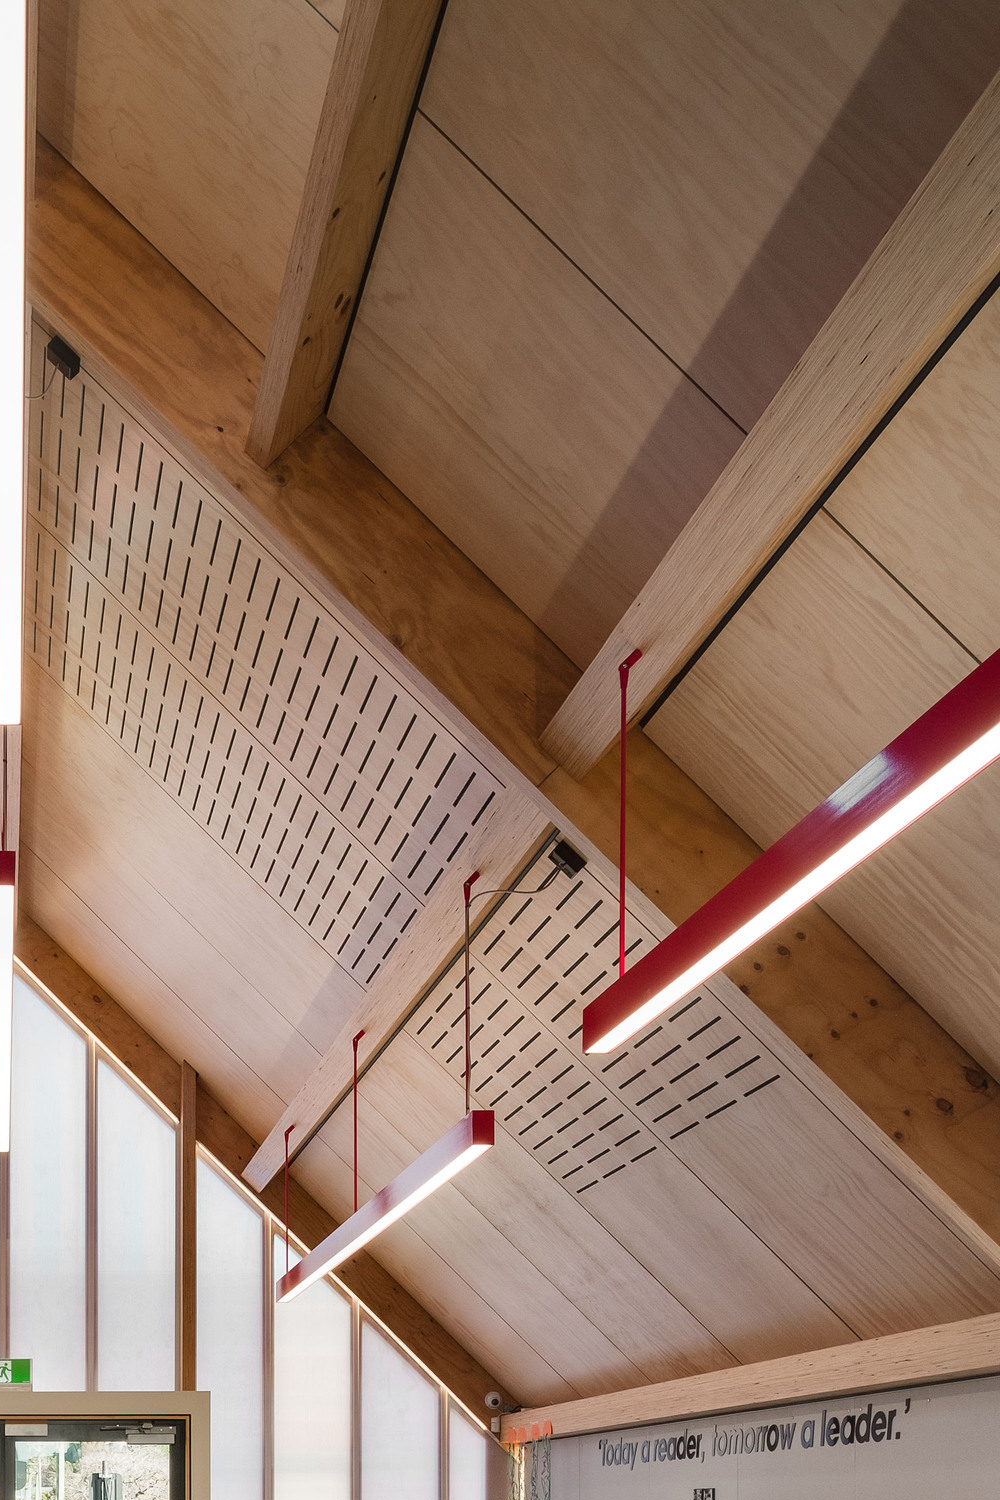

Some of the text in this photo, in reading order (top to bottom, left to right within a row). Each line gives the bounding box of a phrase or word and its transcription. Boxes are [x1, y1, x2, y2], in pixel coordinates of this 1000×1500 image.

[640, 1441, 650, 1463] a
[653, 1428, 705, 1464] reader,
[712, 1421, 796, 1457] tomorrow
[801, 1419, 815, 1449] a
